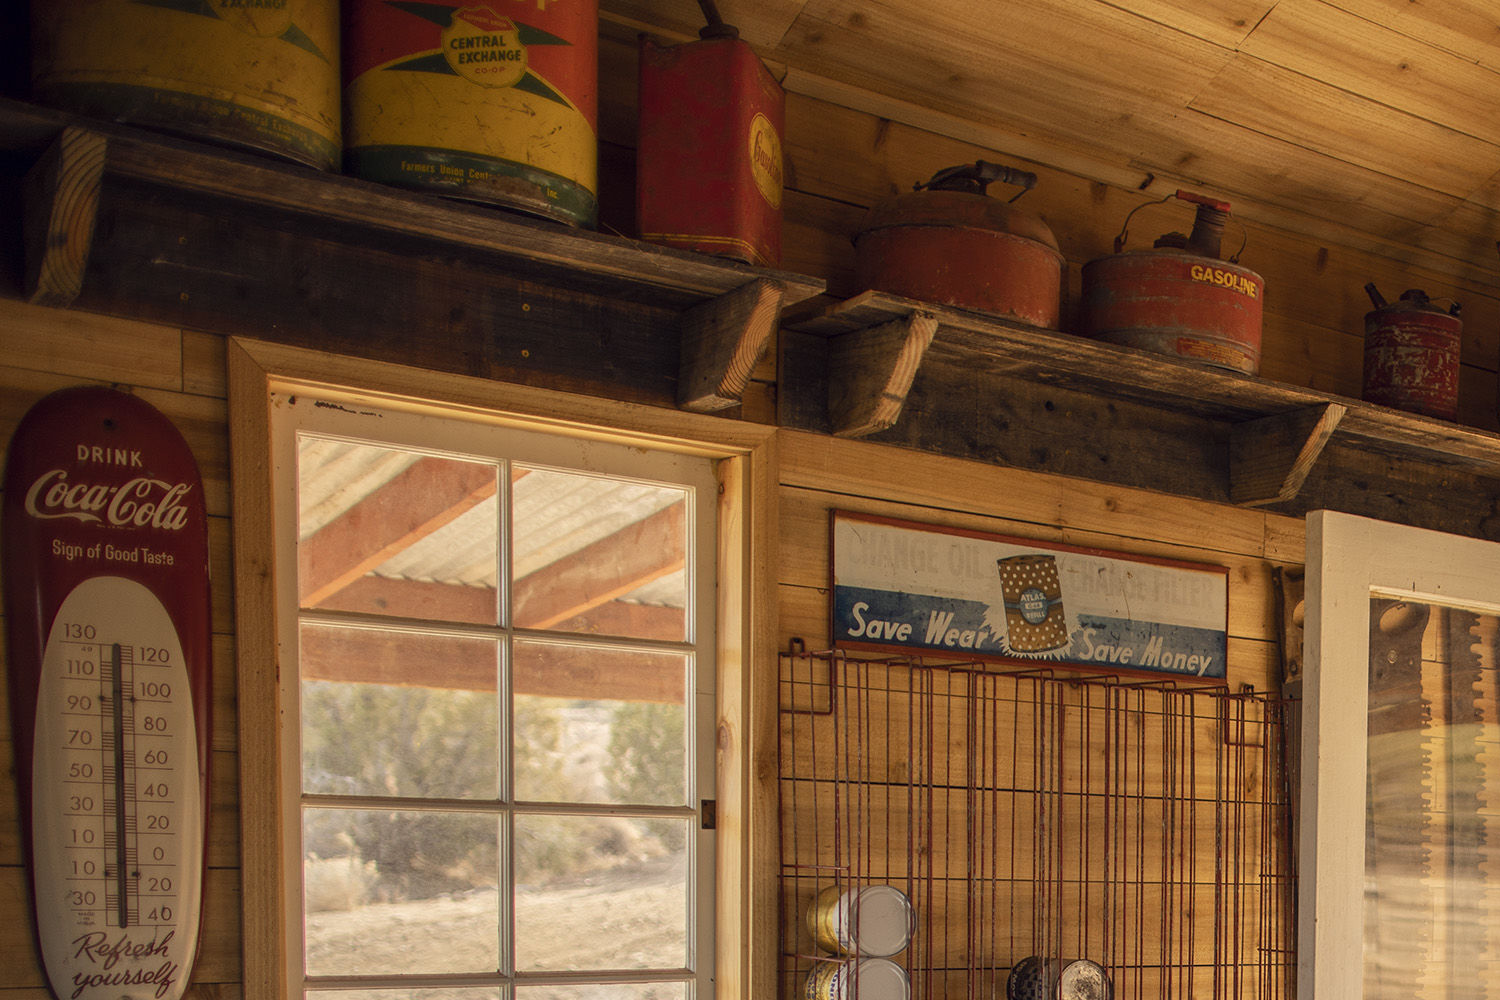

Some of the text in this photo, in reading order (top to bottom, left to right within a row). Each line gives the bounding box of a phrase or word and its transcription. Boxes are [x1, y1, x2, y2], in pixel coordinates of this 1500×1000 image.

[450, 35, 507, 50] CENTRAL
[458, 49, 522, 64] EXCHANGE
[400, 160, 435, 174] Farmers
[439, 163, 465, 177] Union
[1190, 264, 1258, 298] GASOLINE
[76, 444, 144, 468] DRINK
[24, 469, 194, 530] Coca-Cola
[52, 538, 175, 566] Sign of Good Taste
[64, 622, 97, 640] 130
[847, 601, 989, 650] Save Wear
[140, 646, 170, 663] 120
[1078, 627, 1213, 677] Save Money
[67, 659, 94, 676] 110
[141, 682, 171, 698] 100
[67, 695, 92, 711] 90
[144, 716, 167, 732] 80
[68, 729, 92, 745] 70
[144, 750, 168, 765] 60
[69, 763, 93, 778] 50
[144, 783, 169, 798] 40
[70, 796, 94, 812] 30
[147, 815, 170, 830] 20
[72, 829, 95, 844] 10
[153, 846, 165, 861] 0
[72, 860, 96, 875] 10
[148, 877, 172, 892] 20
[72, 891, 96, 906] 30
[148, 906, 173, 921] 40
[71, 930, 176, 971] Refresh
[70, 960, 178, 1000] yourself
